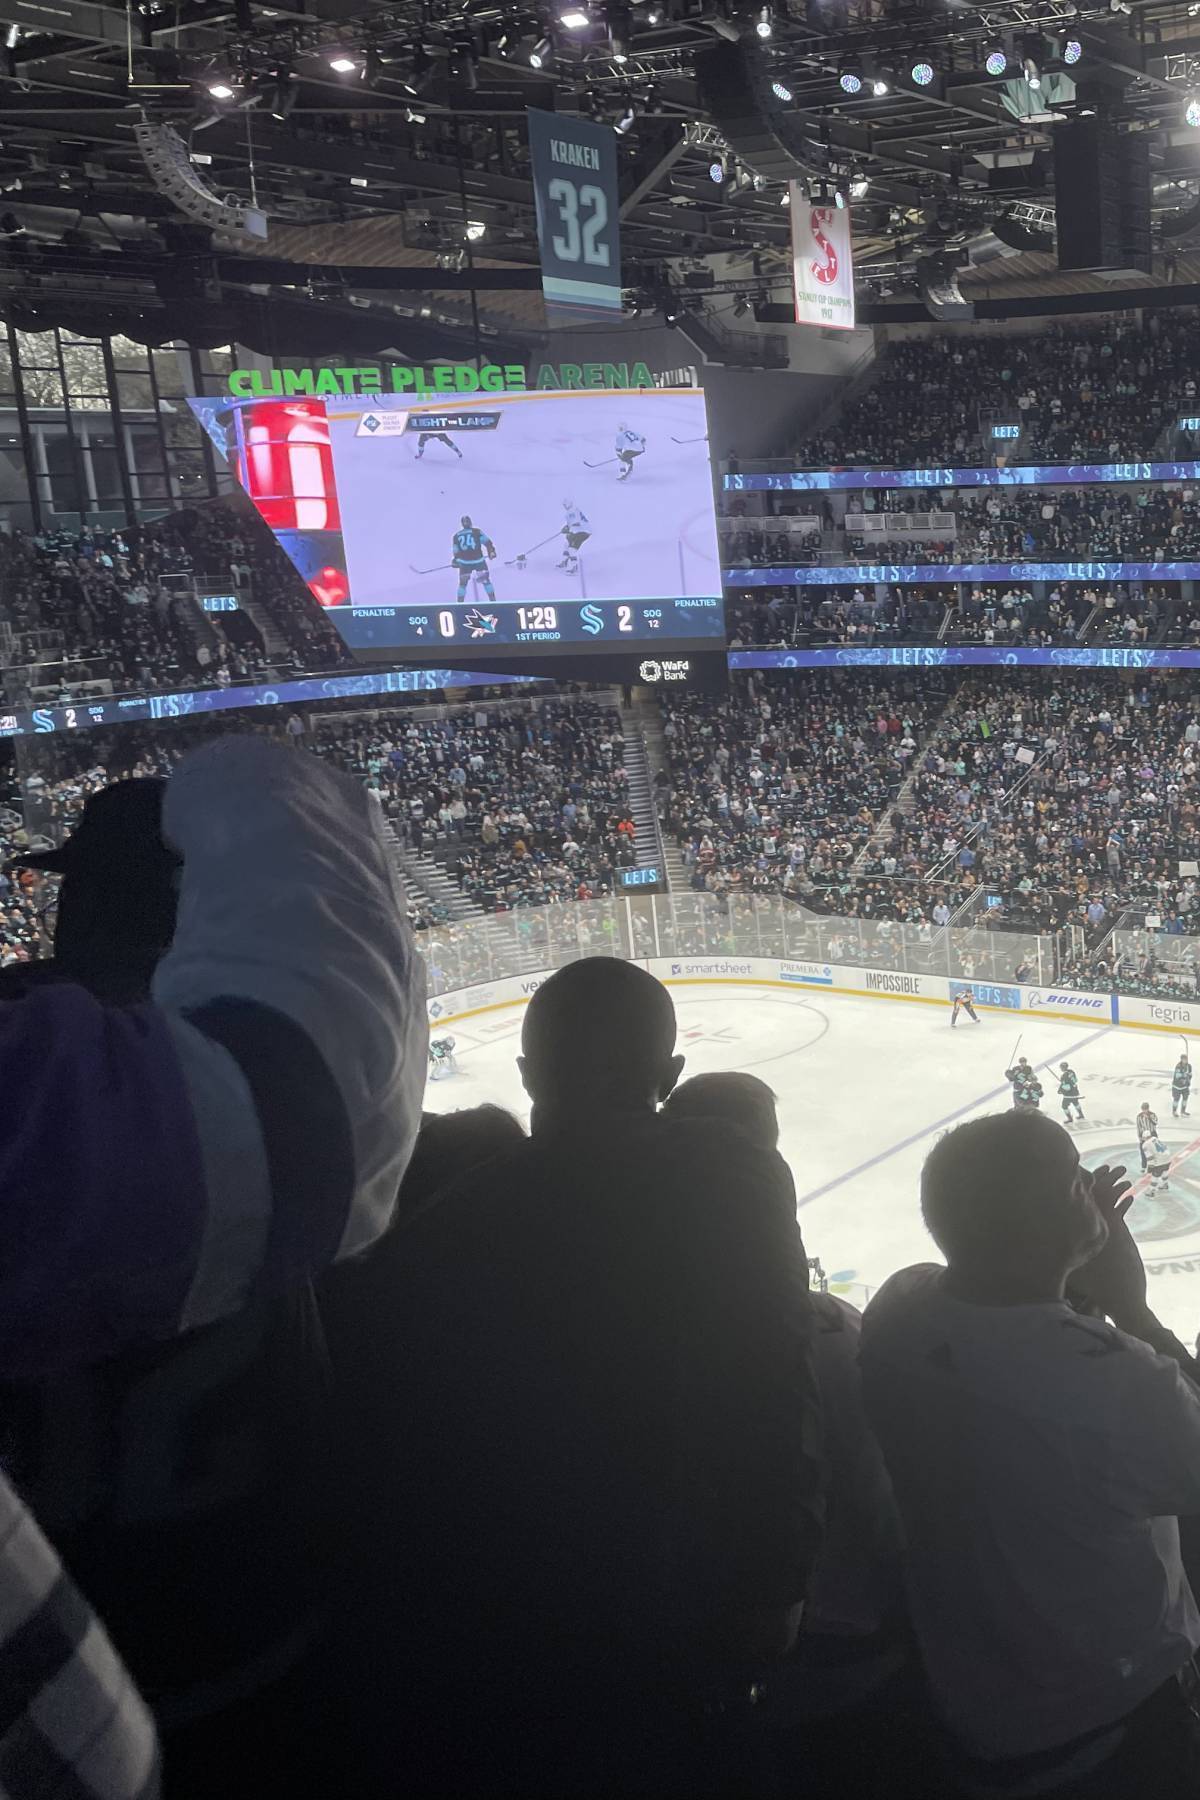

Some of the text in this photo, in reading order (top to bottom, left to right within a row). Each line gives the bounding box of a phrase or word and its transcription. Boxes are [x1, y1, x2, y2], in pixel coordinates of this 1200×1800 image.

[551, 139, 600, 170] KRAKEN
[548, 178, 610, 267] 32
[228, 362, 656, 396] CLIMATE PLEDGE ARENA
[353, 608, 396, 617] PENALTIES
[408, 617, 428, 625] SOG
[439, 611, 456, 637] 0
[517, 606, 557, 630] 1:29
[617, 606, 633, 631] 2
[643, 609, 662, 617] SOG
[674, 599, 717, 607] PENALTIES
[416, 627, 423, 635] 4
[532, 632, 560, 640] PERIOD
[648, 620, 659, 628] 12
[662, 661, 689, 670] WaFd
[664, 671, 687, 680] Bank
[65, 709, 77, 727] 2
[685, 961, 752, 975] smartsheet
[866, 972, 920, 994] IMPOSSIBLE
[1047, 994, 1103, 1009] BOEING
[1148, 1003, 1190, 1023] Tegria
